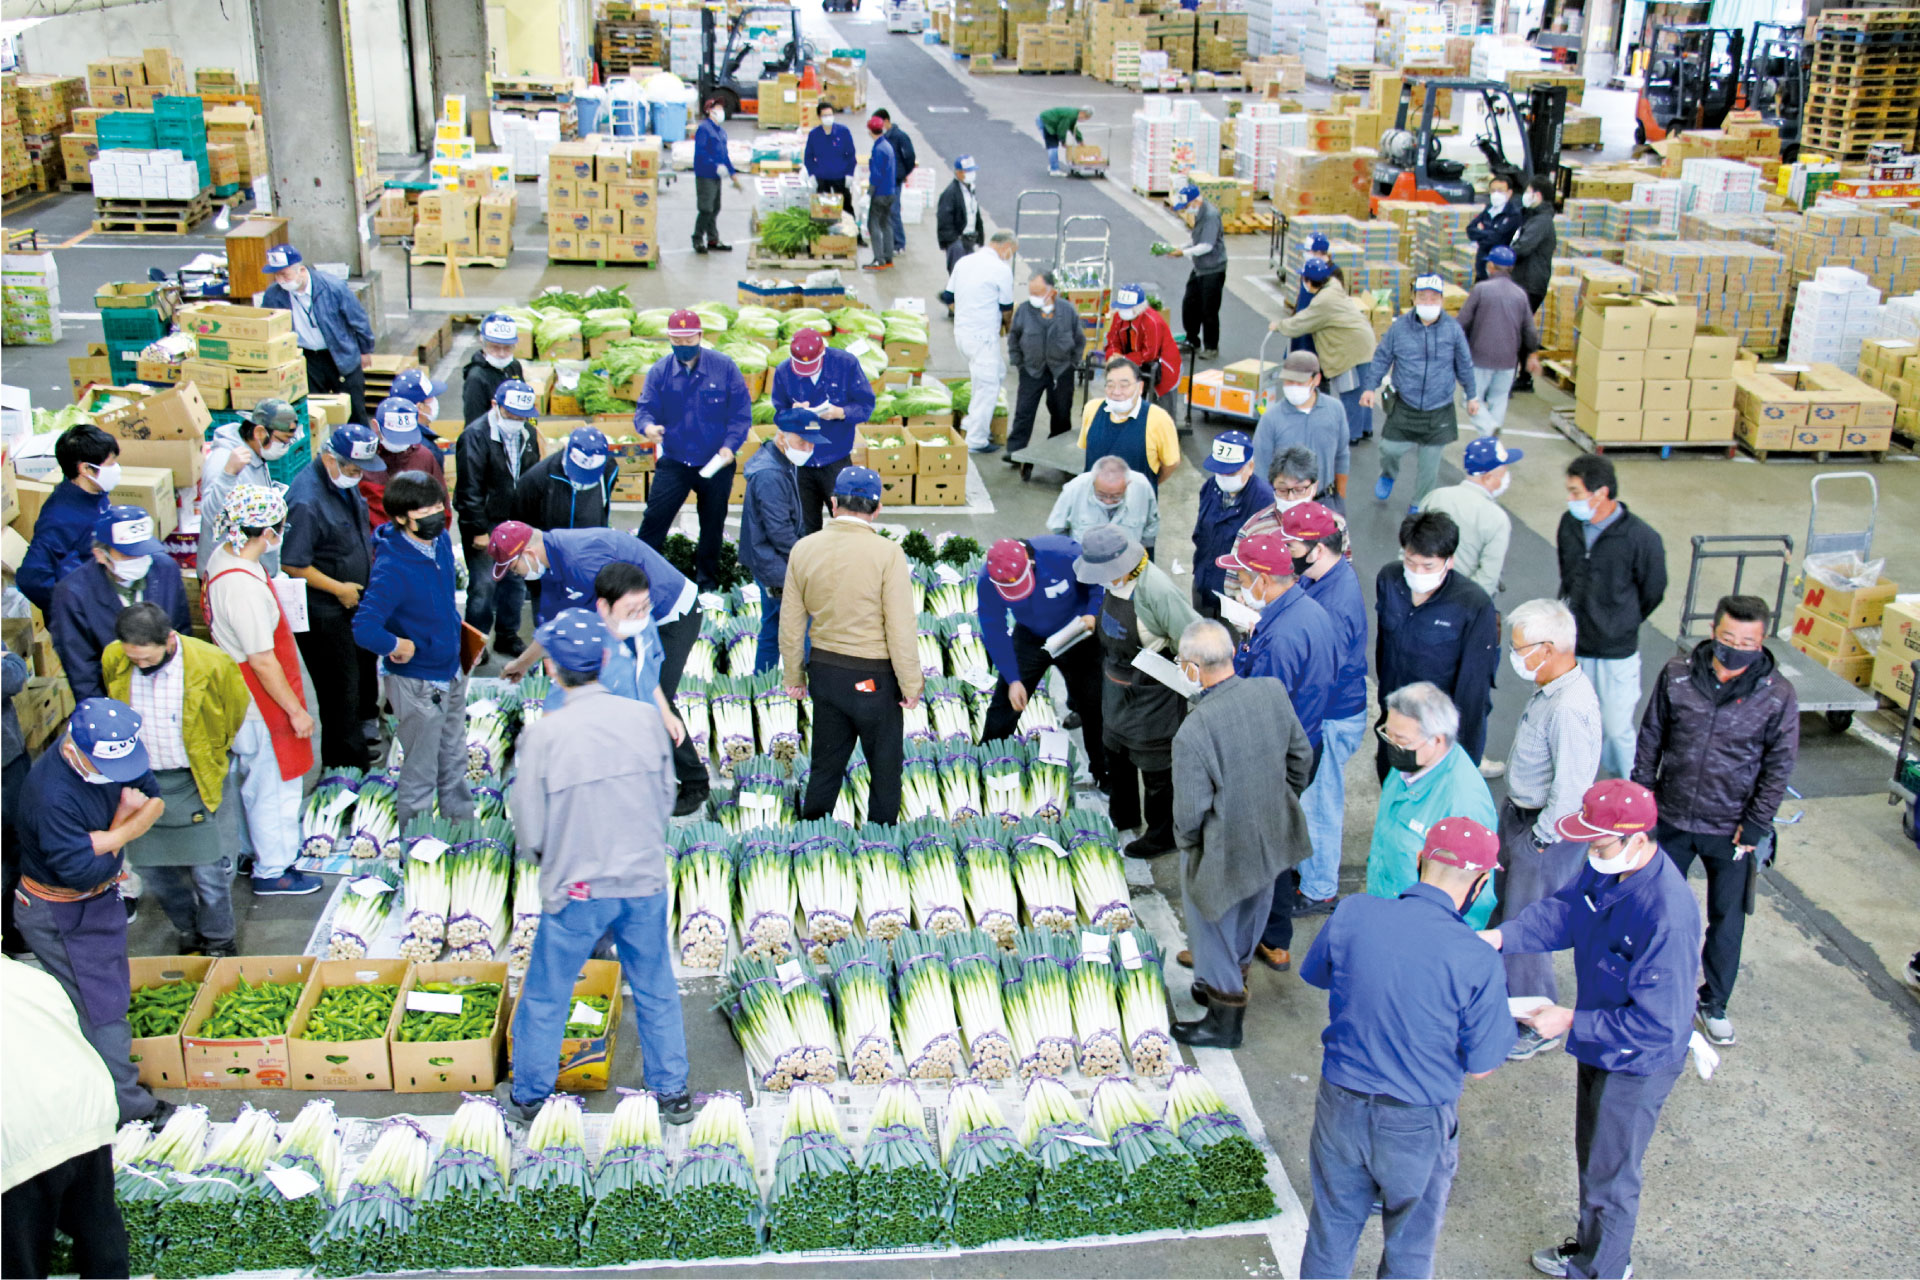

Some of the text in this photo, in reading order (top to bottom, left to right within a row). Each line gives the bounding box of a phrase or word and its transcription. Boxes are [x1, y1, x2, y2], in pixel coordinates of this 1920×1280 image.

[494, 323, 511, 333] 203
[516, 394, 533, 404] 149
[1217, 445, 1232, 457] 37
[1805, 588, 1824, 608] N
[1794, 617, 1814, 636] N
